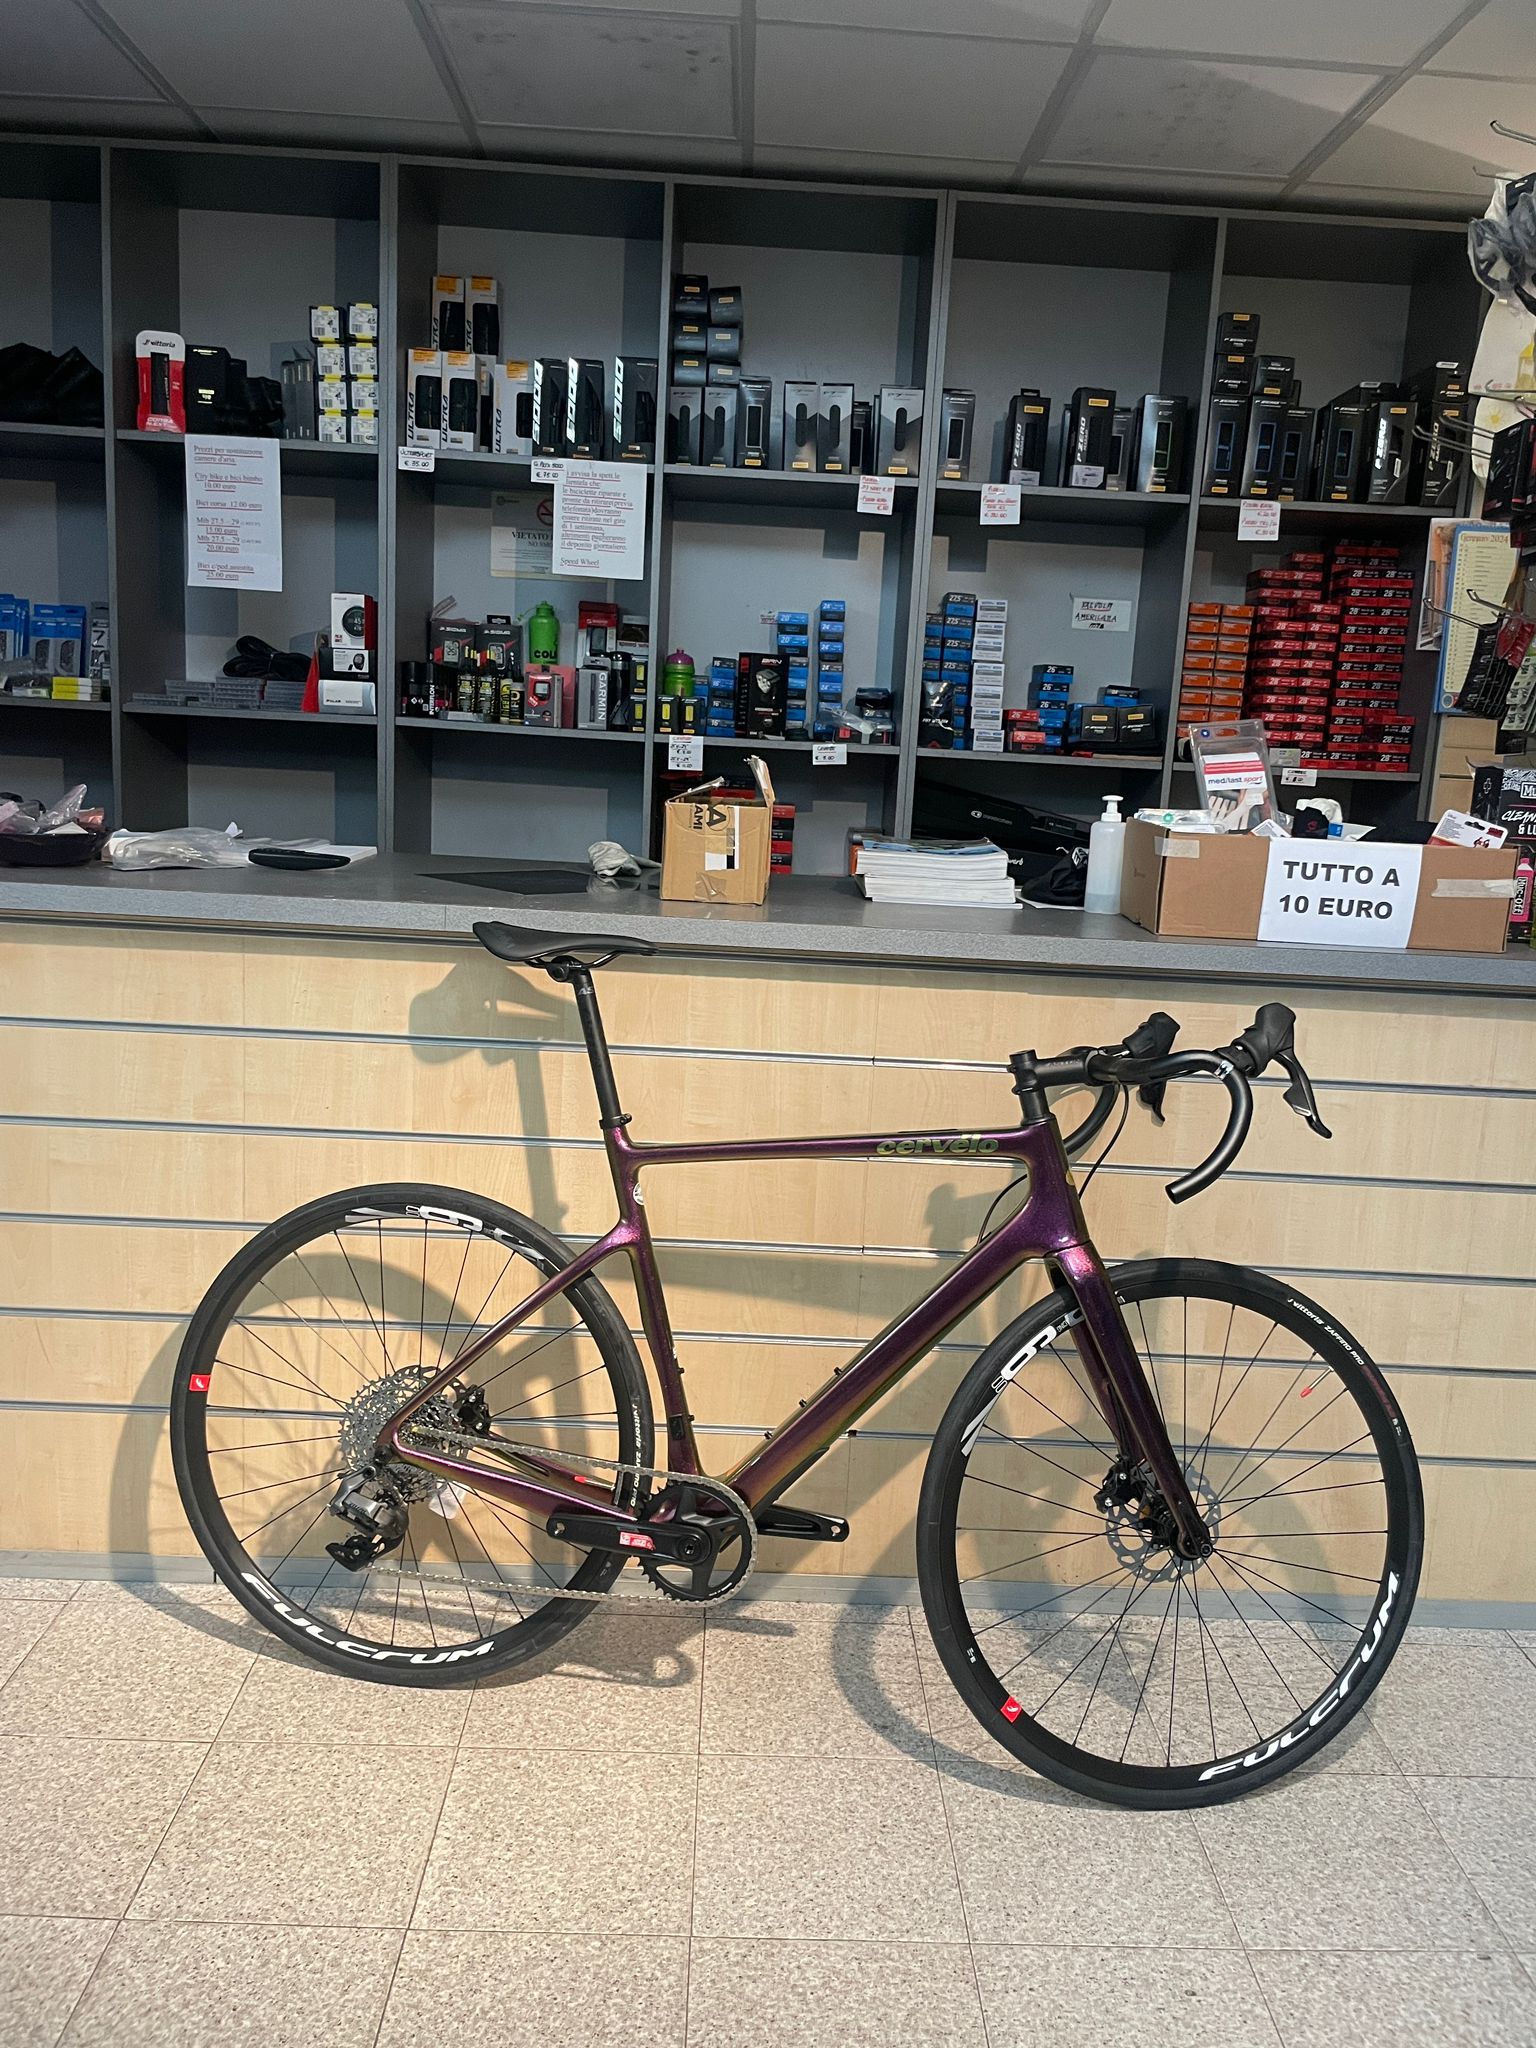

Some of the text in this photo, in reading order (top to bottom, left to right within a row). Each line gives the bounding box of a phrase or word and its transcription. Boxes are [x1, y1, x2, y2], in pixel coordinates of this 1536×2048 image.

[407, 392, 415, 440] ULTRA
[441, 395, 449, 443] ULTRA
[494, 408, 502, 453] ULTRA
[512, 531, 548, 540] VIETATO
[598, 672, 608, 720] GARMIN
[693, 805, 703, 830] AMI
[1283, 861, 1400, 887] TUTTO A
[1280, 895, 1393, 920] 10 EURO
[1293, 1301, 1326, 1325] vittoria
[1350, 1351, 1365, 1366] PRO
[633, 1409, 642, 1448] vittoria
[241, 1572, 494, 1665] FULCRUM
[1198, 1571, 1400, 1782] FULCRUM
